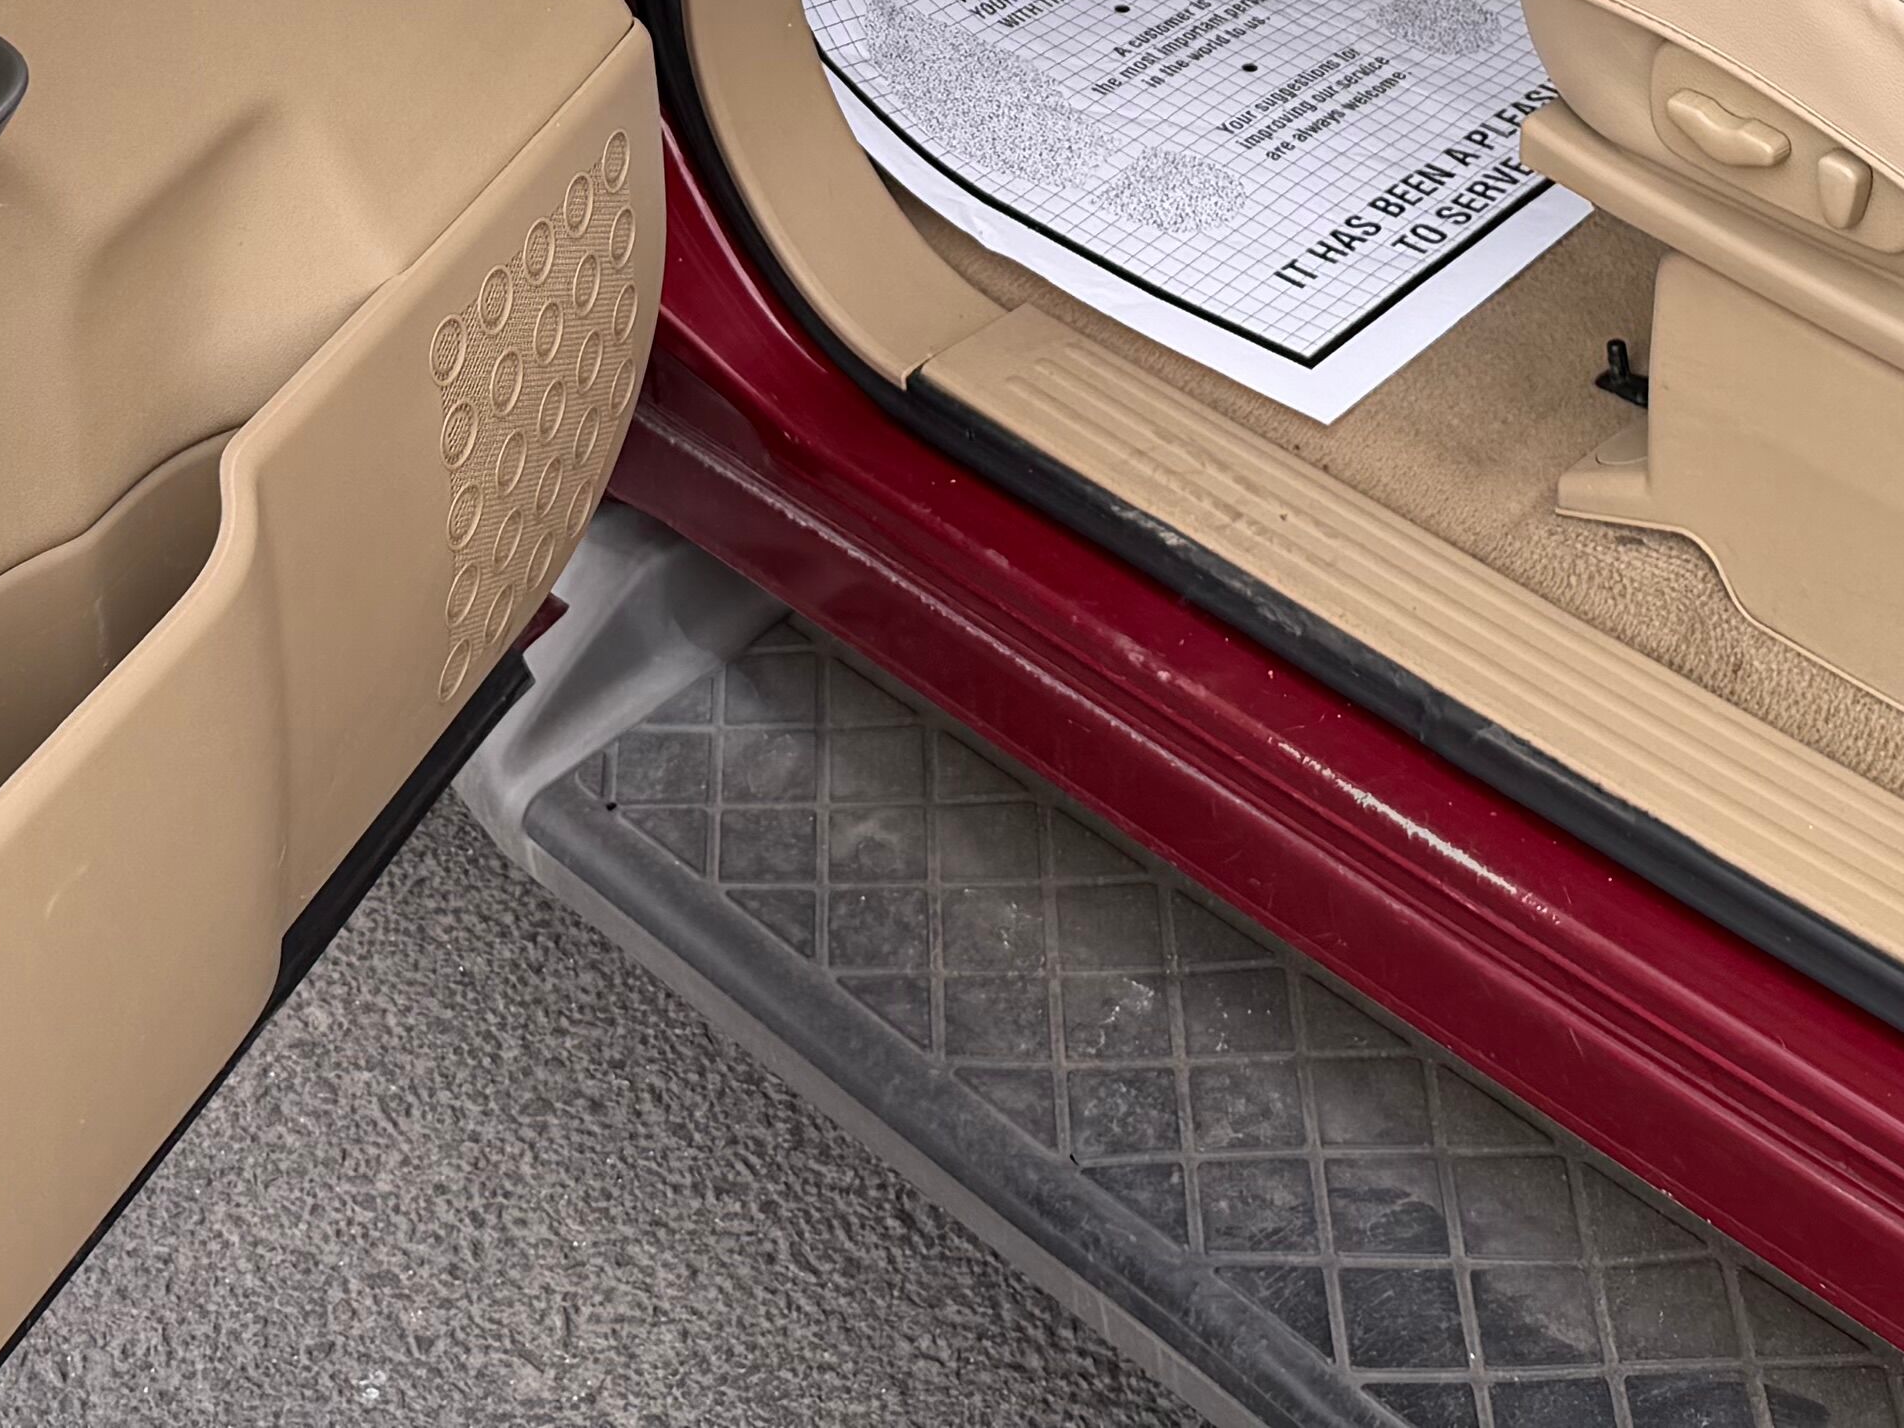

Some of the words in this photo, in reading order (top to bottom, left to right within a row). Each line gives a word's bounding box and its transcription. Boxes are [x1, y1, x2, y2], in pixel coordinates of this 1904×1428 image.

[997, 3, 1044, 30] WITH
[1091, 76, 1123, 96] the
[1119, 51, 1160, 80] most
[1154, 12, 1229, 56] important
[1113, 45, 1132, 58] A
[1127, 8, 1196, 50] customer
[1141, 73, 1166, 89] in
[1159, 58, 1190, 74] the
[1187, 34, 1231, 62] world
[1224, 27, 1246, 43] to
[1216, 108, 1258, 136] Your
[1254, 56, 1341, 113] suggestions
[1334, 46, 1362, 63] for
[1235, 100, 1318, 151] improving
[1311, 85, 1339, 104] our
[1336, 55, 1390, 90] service
[1265, 139, 1296, 162] are
[1292, 105, 1346, 143] always
[1341, 70, 1413, 112] welcome.
[1273, 258, 1318, 289] IT
[1306, 214, 1383, 265] HAS
[1368, 162, 1456, 218] BEEN
[1442, 147, 1481, 167] A
[1392, 222, 1447, 255] TO
[1435, 156, 1535, 225] SERVE
